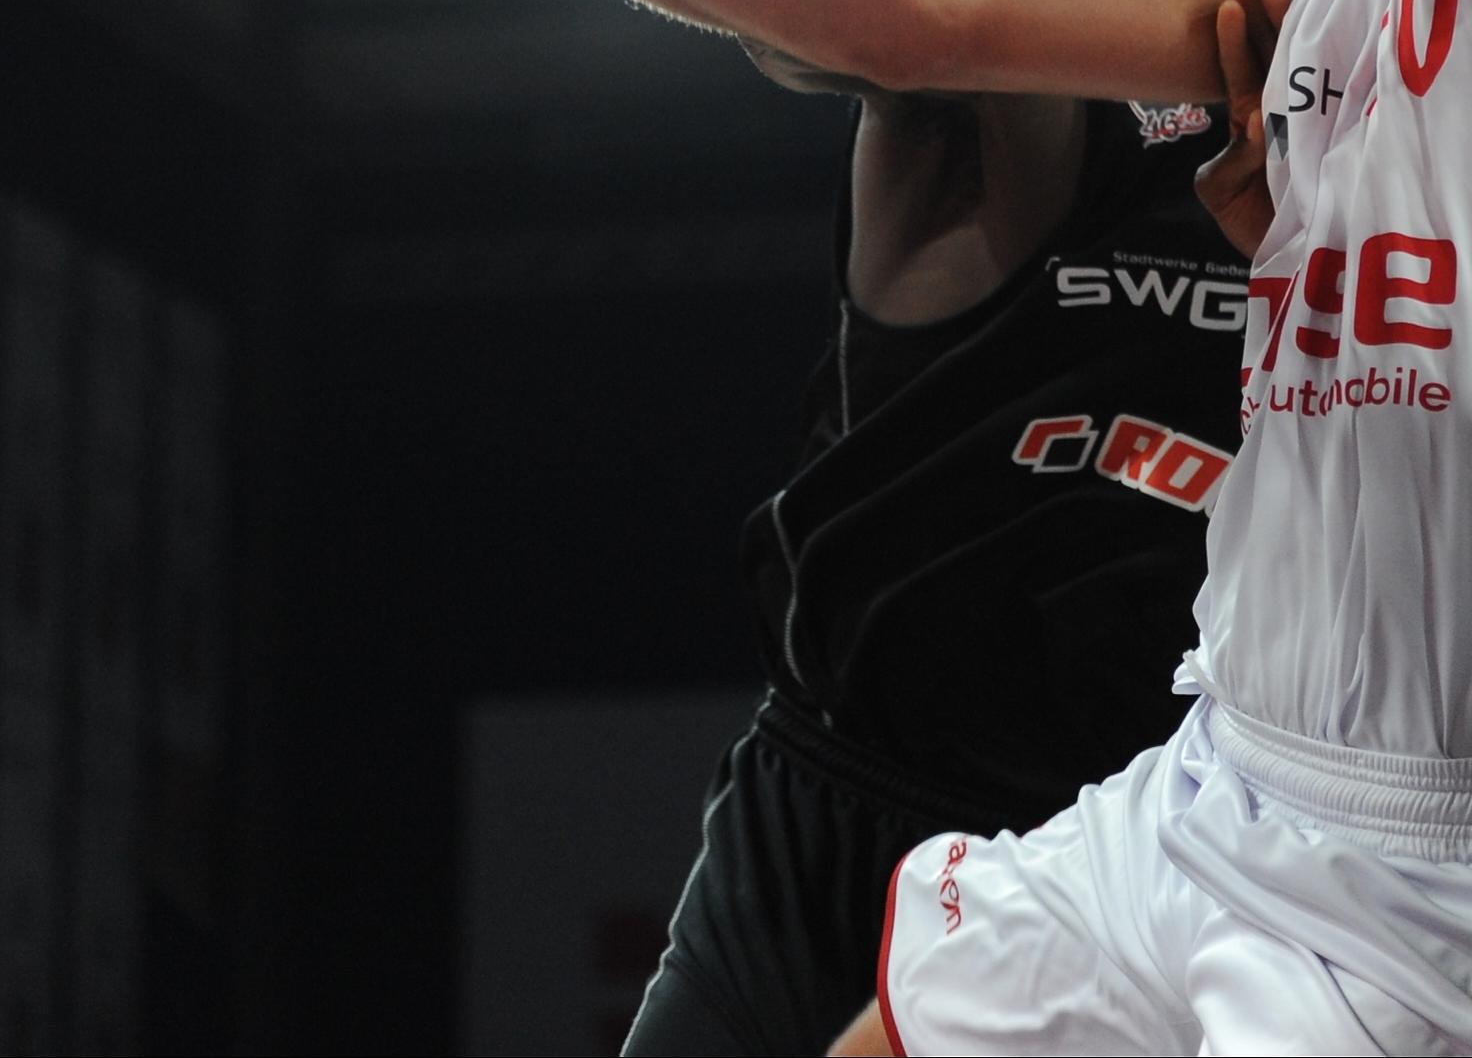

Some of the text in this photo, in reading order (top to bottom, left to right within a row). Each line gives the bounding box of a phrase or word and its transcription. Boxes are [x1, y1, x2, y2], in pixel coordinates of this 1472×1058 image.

[1112, 250, 1198, 272] Stadtwerke
[1056, 265, 1249, 332] SWG
[1095, 414, 1237, 516] RO
